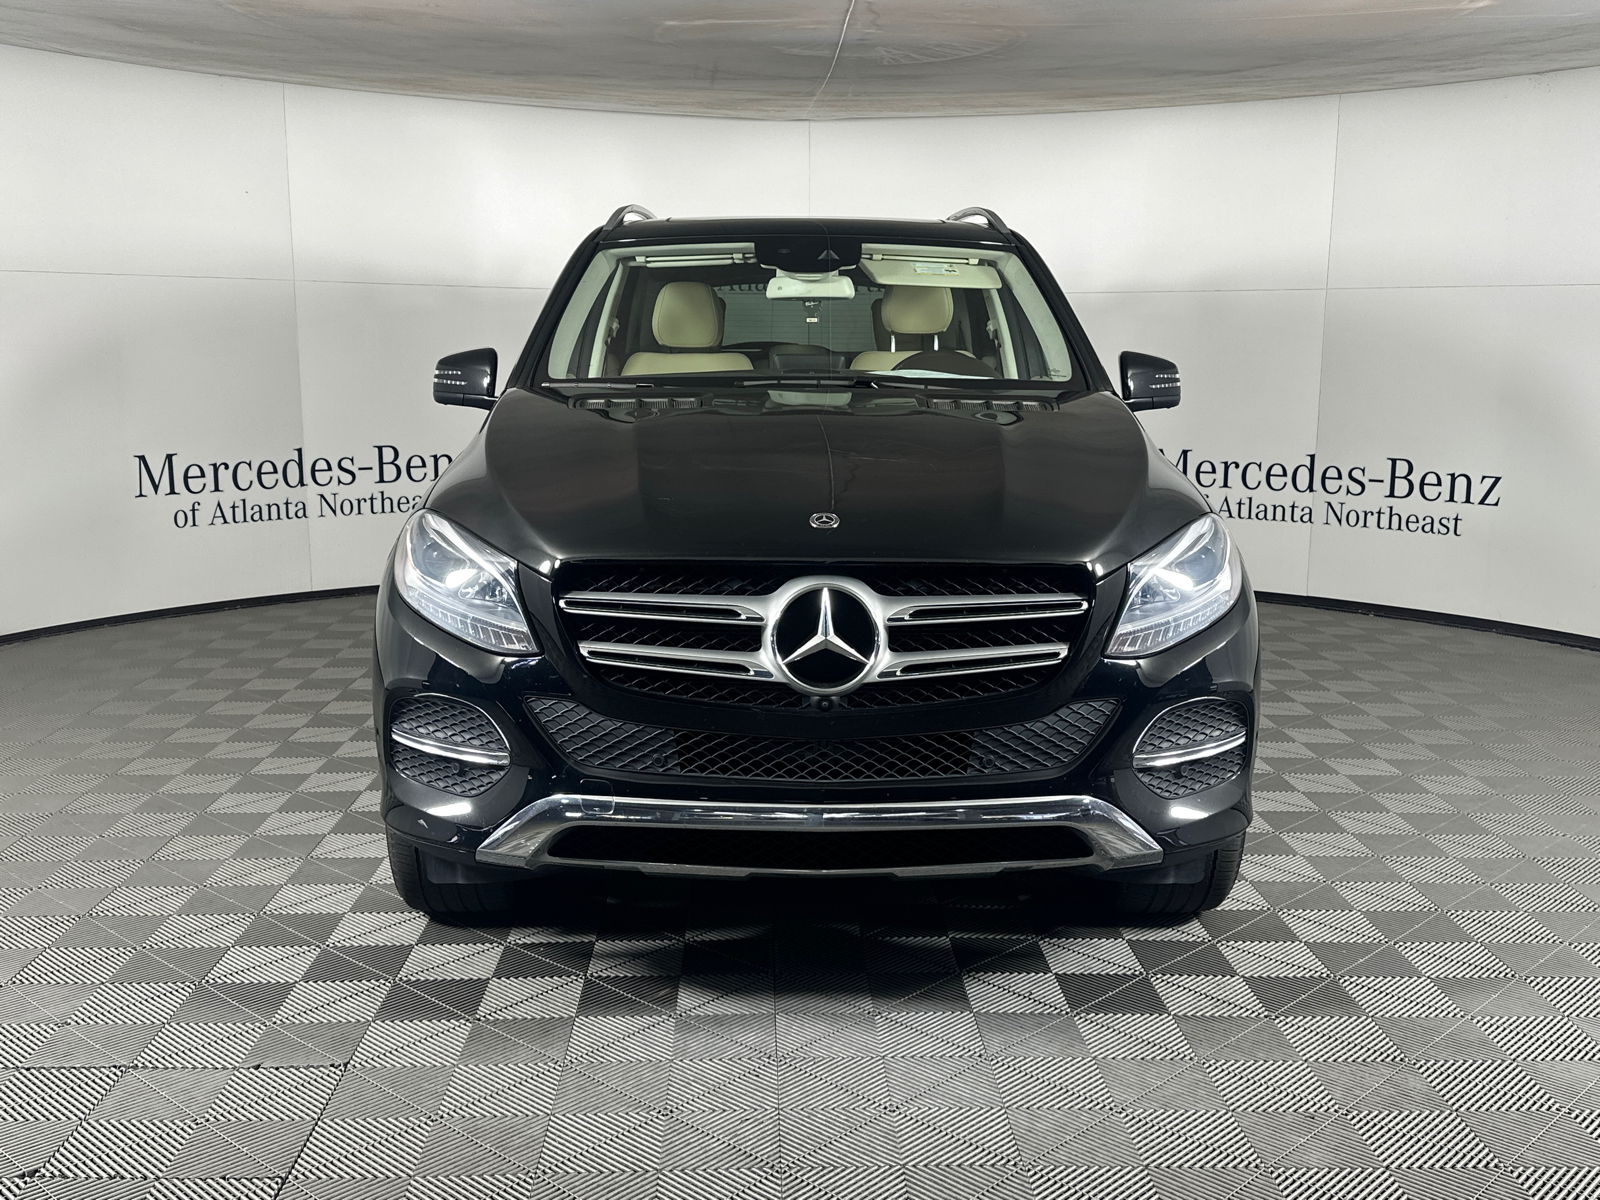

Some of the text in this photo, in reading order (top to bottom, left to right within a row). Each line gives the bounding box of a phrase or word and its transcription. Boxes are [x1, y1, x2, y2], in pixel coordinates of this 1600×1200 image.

[133, 445, 453, 499] Mercedes-Ben
[173, 491, 422, 529] of Atlanta Northea
[1218, 495, 1463, 537] Atlanta Northeast
